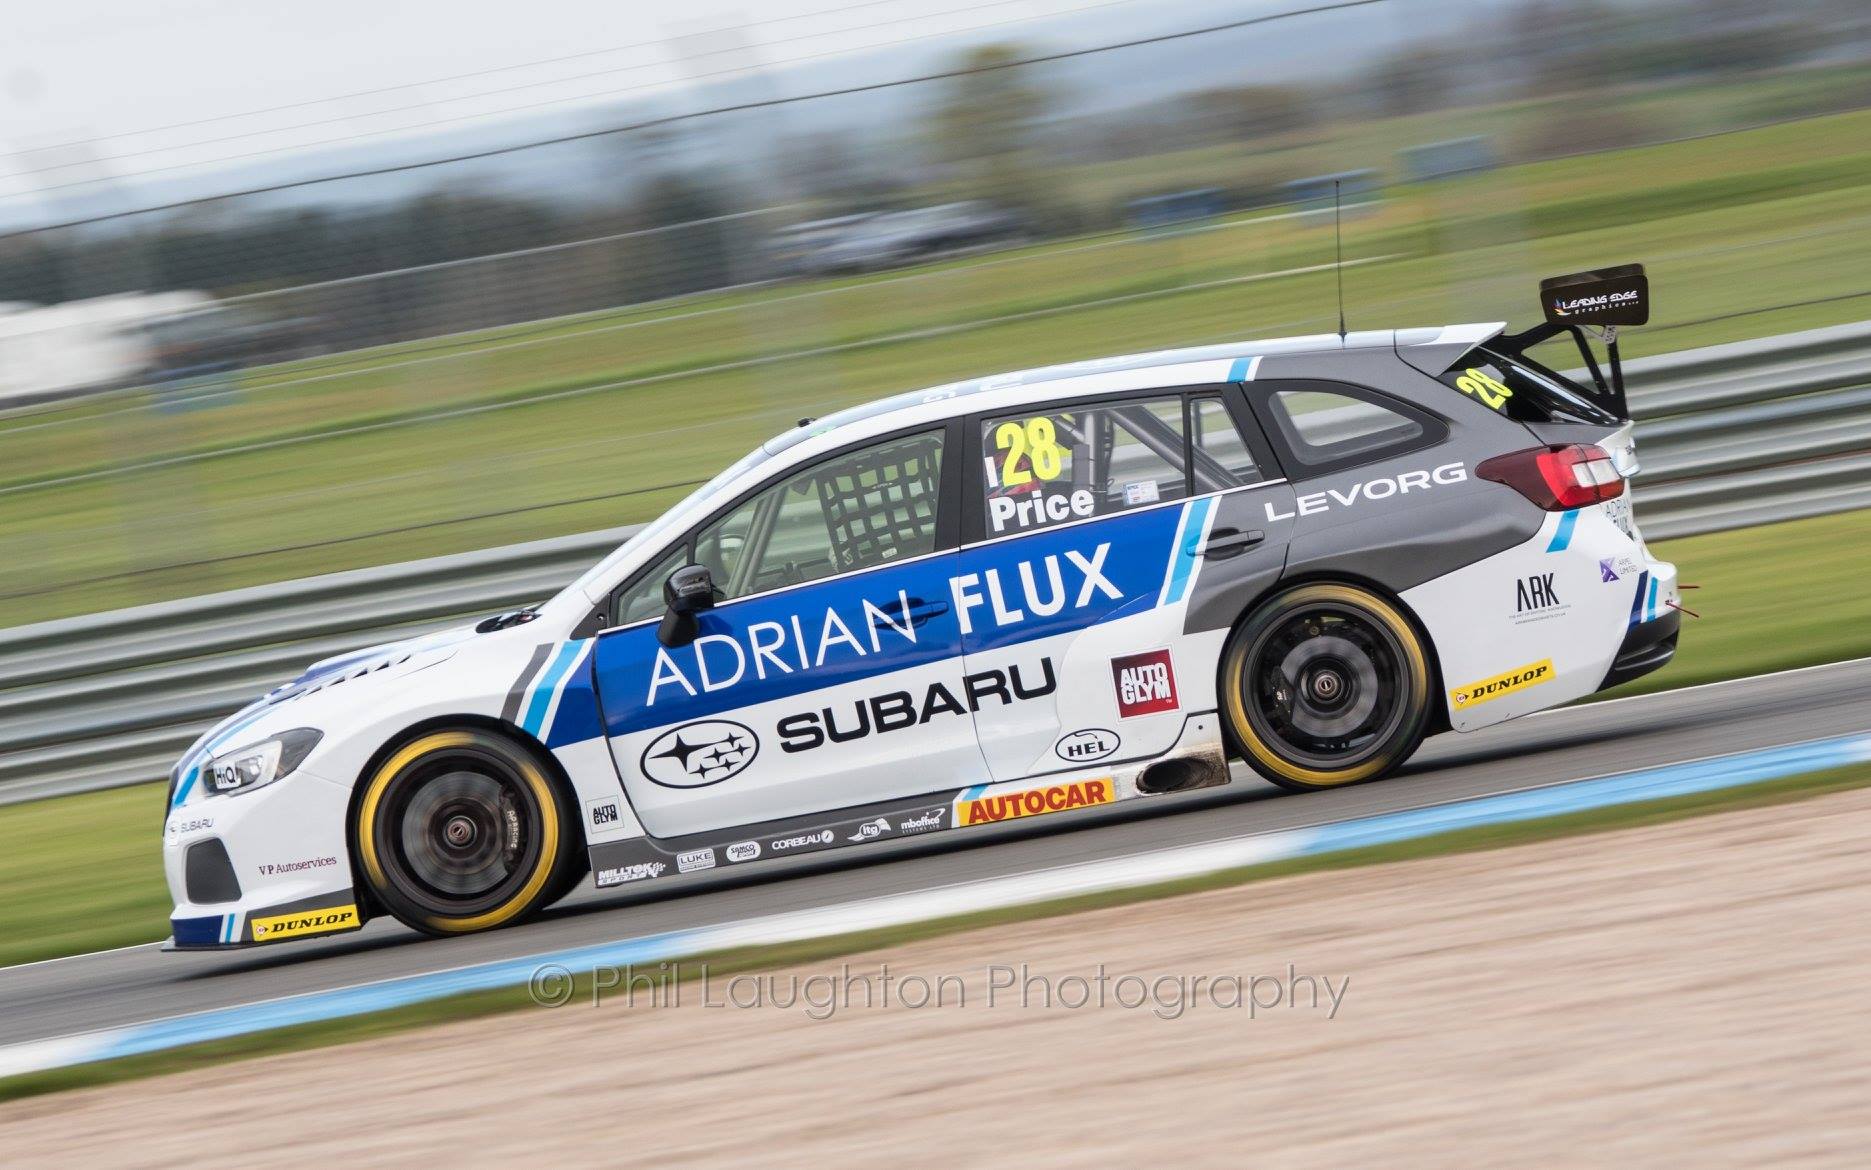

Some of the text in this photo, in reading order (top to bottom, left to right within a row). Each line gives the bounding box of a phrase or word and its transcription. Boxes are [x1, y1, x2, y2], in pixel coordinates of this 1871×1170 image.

[1562, 290, 1638, 309] LEADING EDGE
[1456, 368, 1514, 410] 28
[996, 416, 1062, 487] 28
[1264, 461, 1468, 522] LEVORG
[989, 489, 1095, 532] Price
[646, 542, 1124, 706] ADRIAN FLUX
[1120, 662, 1168, 687] AUTO
[1471, 665, 1548, 700] DUNLOP
[1121, 680, 1172, 705] GLYM
[777, 657, 1057, 754] SUBARU
[1067, 740, 1110, 757] HEL
[593, 804, 616, 817] AUTO
[968, 779, 1106, 824] AUTOCAR
[181, 818, 214, 833] SUBARU
[594, 812, 618, 825] GLYM
[771, 833, 821, 850] CORBEAU
[276, 856, 337, 873] Autoservices
[680, 852, 712, 865] LUKE
[271, 912, 353, 933] DUNLOP
